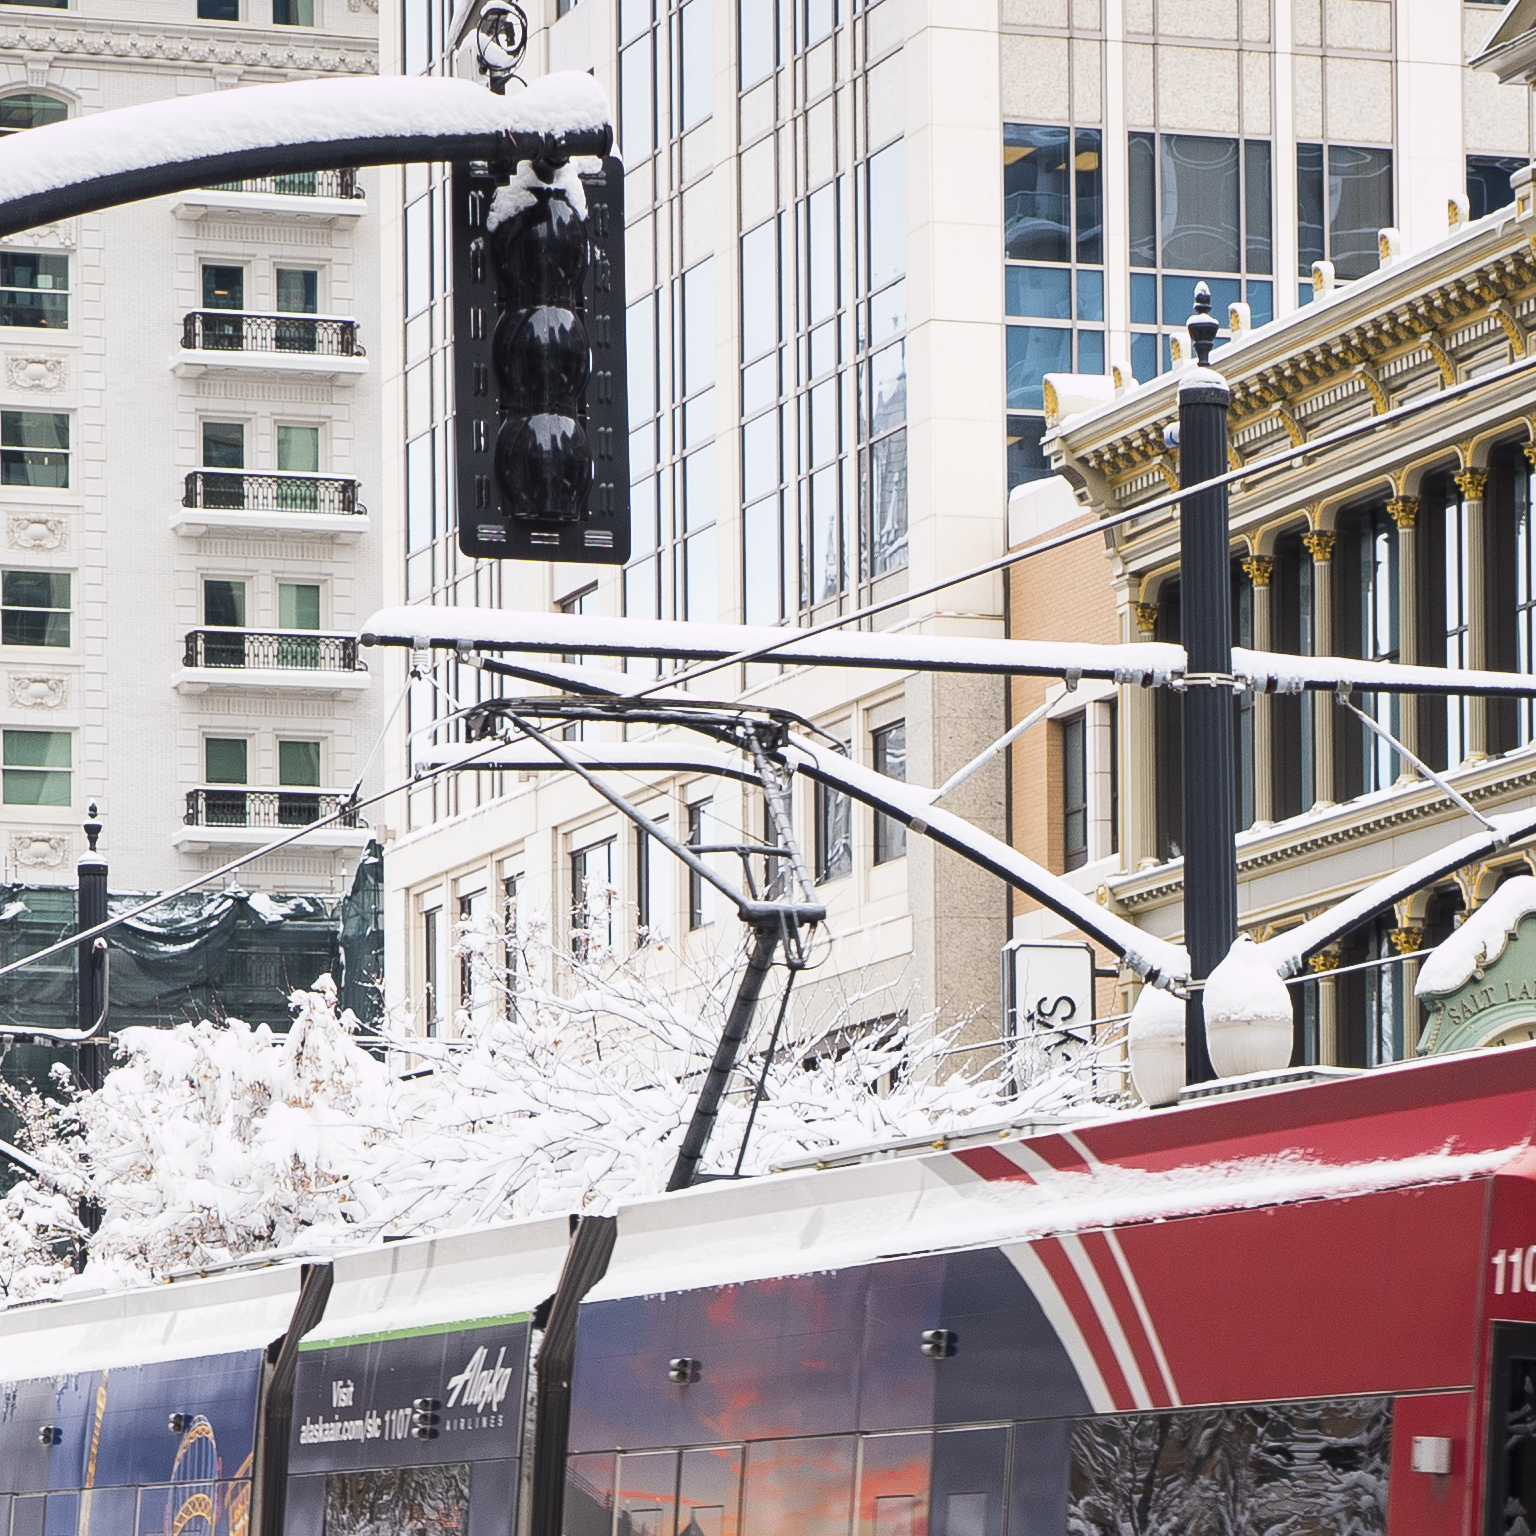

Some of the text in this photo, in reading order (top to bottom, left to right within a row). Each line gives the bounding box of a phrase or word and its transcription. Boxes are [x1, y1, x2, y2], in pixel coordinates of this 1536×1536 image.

[1447, 986, 1497, 1026] SALT
[332, 1379, 355, 1408] Visit
[384, 1407, 413, 1441] 1107
